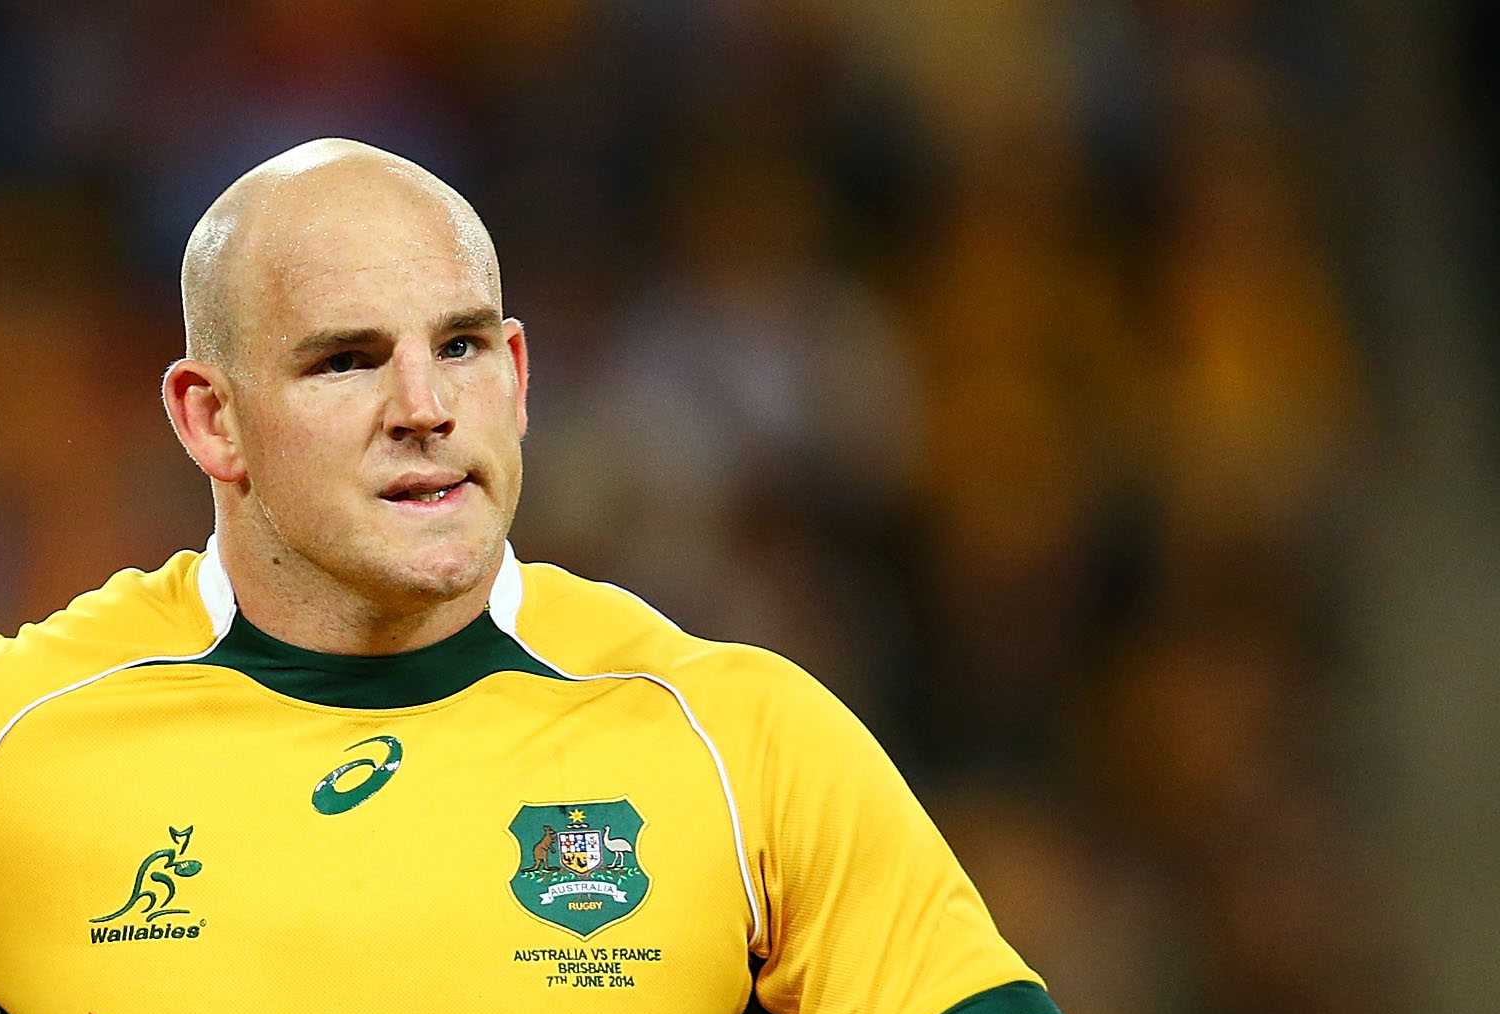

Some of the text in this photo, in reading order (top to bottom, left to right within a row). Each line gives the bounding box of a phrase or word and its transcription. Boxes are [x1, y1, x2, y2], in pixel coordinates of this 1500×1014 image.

[551, 883, 614, 895] AUSTRALIA
[568, 902, 603, 910] RUGBY
[90, 923, 200, 944] Wallabies
[514, 948, 661, 961] AUSTRALIA VS FRANCE
[558, 962, 621, 974] BRISBANE
[546, 976, 635, 987] 7TH JUNE 2014
